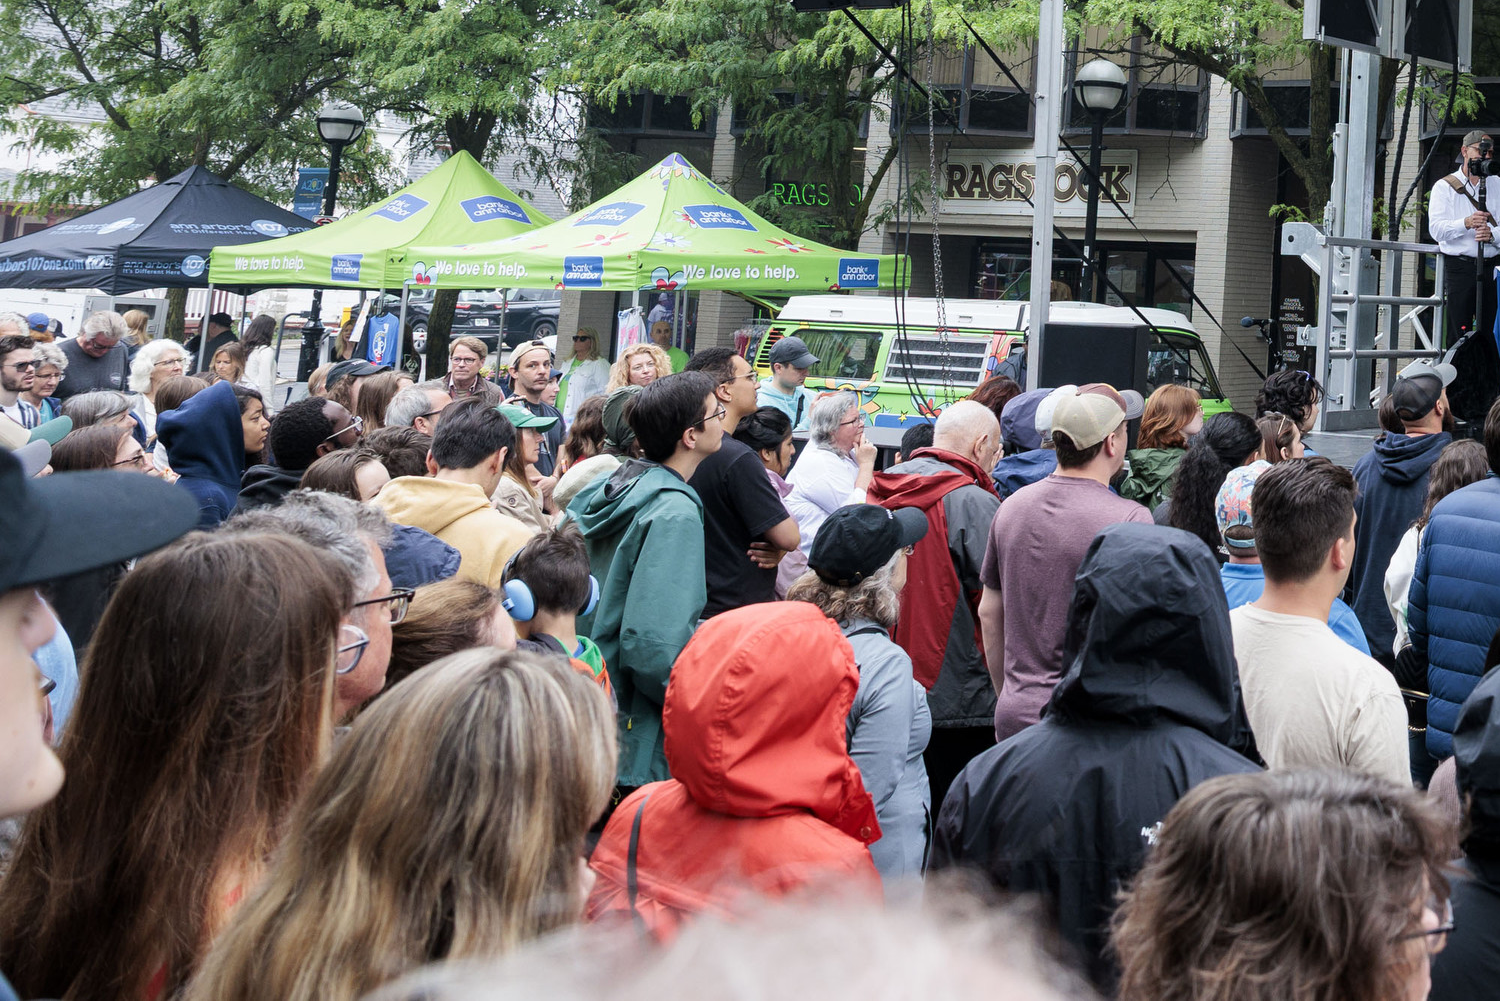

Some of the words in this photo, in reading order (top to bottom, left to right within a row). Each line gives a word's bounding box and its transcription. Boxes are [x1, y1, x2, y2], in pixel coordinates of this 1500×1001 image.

[944, 162, 1132, 203] RAGSOK
[477, 201, 502, 211] bank
[473, 207, 497, 217] ann
[497, 207, 523, 219] arbor
[701, 210, 727, 219] bank
[700, 216, 720, 225] ann
[721, 217, 748, 226] arbor
[169, 223, 199, 231] ann
[201, 223, 254, 232] arbor's
[256, 223, 283, 232] 107
[145, 260, 181, 270] arbor's
[185, 260, 204, 269] 107
[235, 257, 249, 271] We
[250, 257, 270, 271] love
[271, 257, 282, 270] to
[284, 255, 307, 273] help.
[571, 263, 589, 273] bank
[435, 260, 452, 275] We
[455, 260, 481, 276] love
[483, 261, 496, 276] to
[498, 262, 529, 280] help.
[682, 264, 706, 279] We
[710, 265, 741, 280] love
[746, 265, 760, 279] to
[764, 264, 800, 281] help.
[847, 266, 865, 275] bank
[566, 271, 583, 279] ann
[583, 271, 600, 280] arbor
[842, 272, 856, 281] ann
[857, 272, 875, 281] arbor
